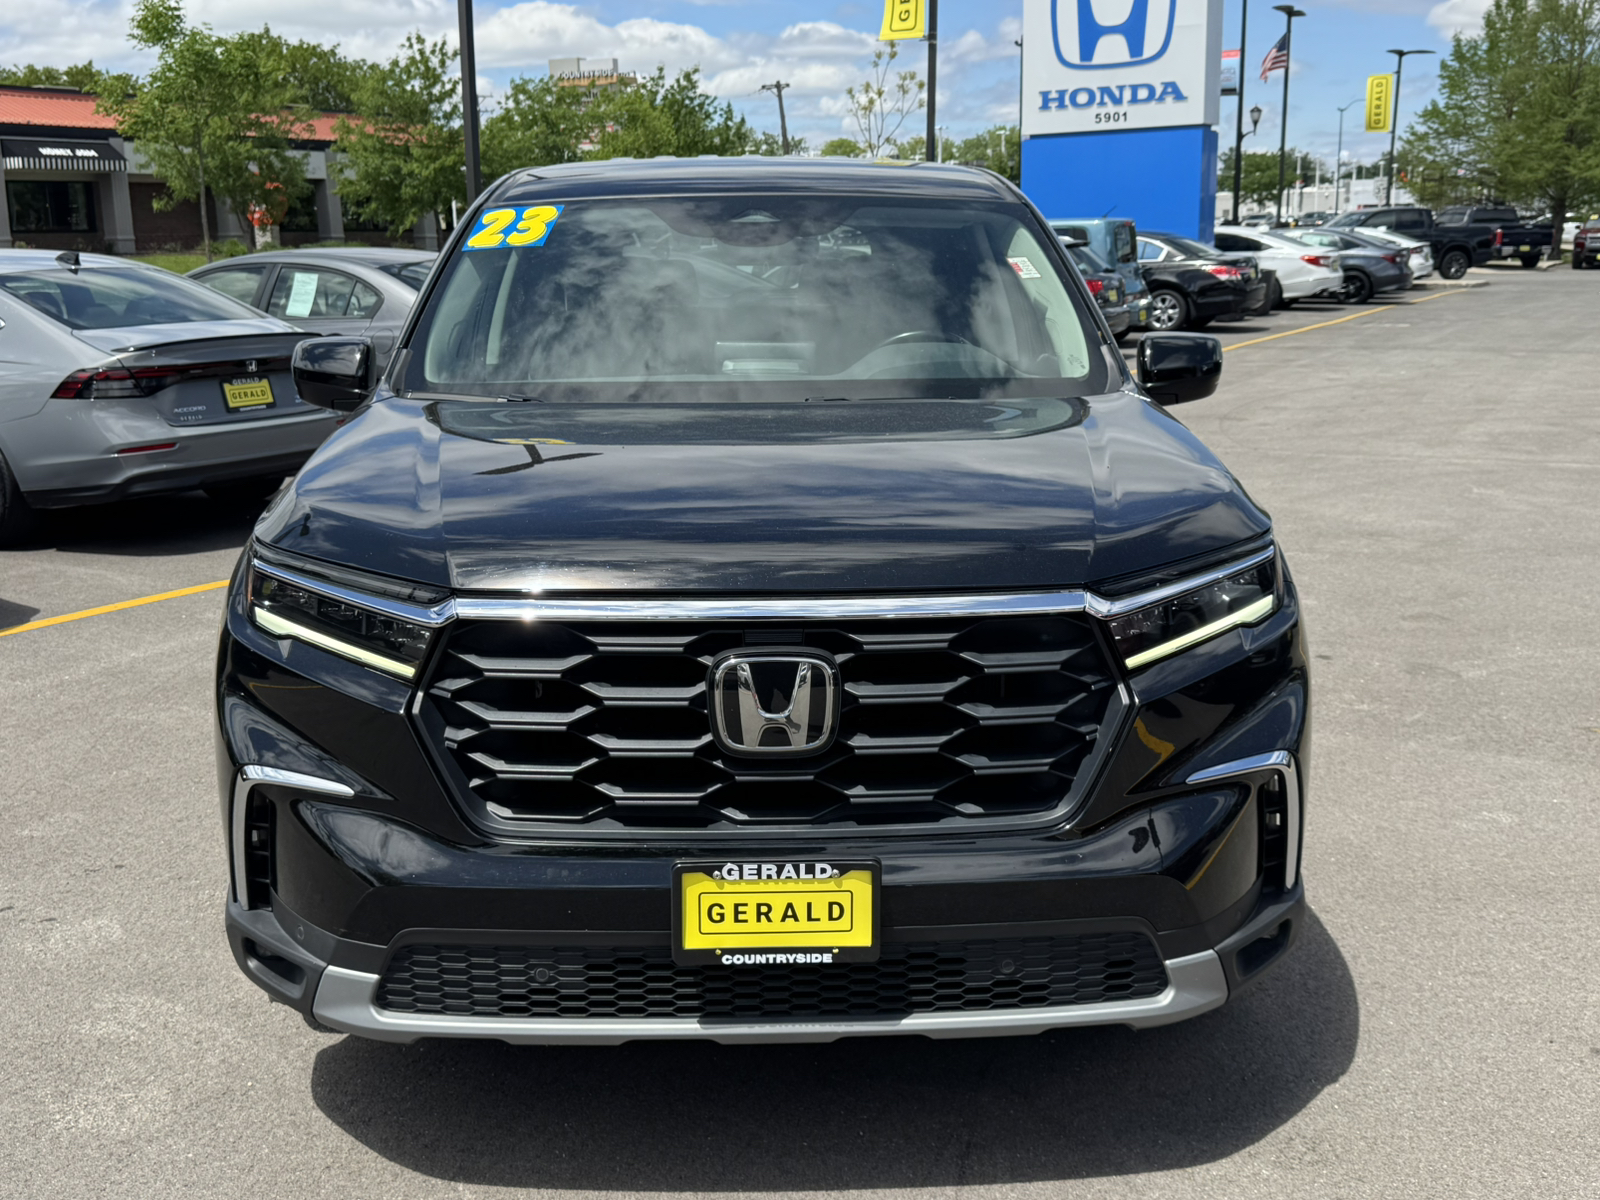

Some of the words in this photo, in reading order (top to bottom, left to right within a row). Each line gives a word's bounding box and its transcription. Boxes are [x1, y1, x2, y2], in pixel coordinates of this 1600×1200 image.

[1038, 81, 1188, 111] HONDA
[1373, 81, 1384, 126] GERALD
[1094, 111, 1128, 124] 5901
[467, 205, 559, 249] 23
[232, 377, 260, 386] GERALD
[231, 389, 267, 401] GERALD
[173, 405, 207, 414] ACCORD
[721, 863, 832, 881] GERALD
[706, 901, 845, 924] GERALD
[721, 953, 833, 965] COUNTRYSIDE
